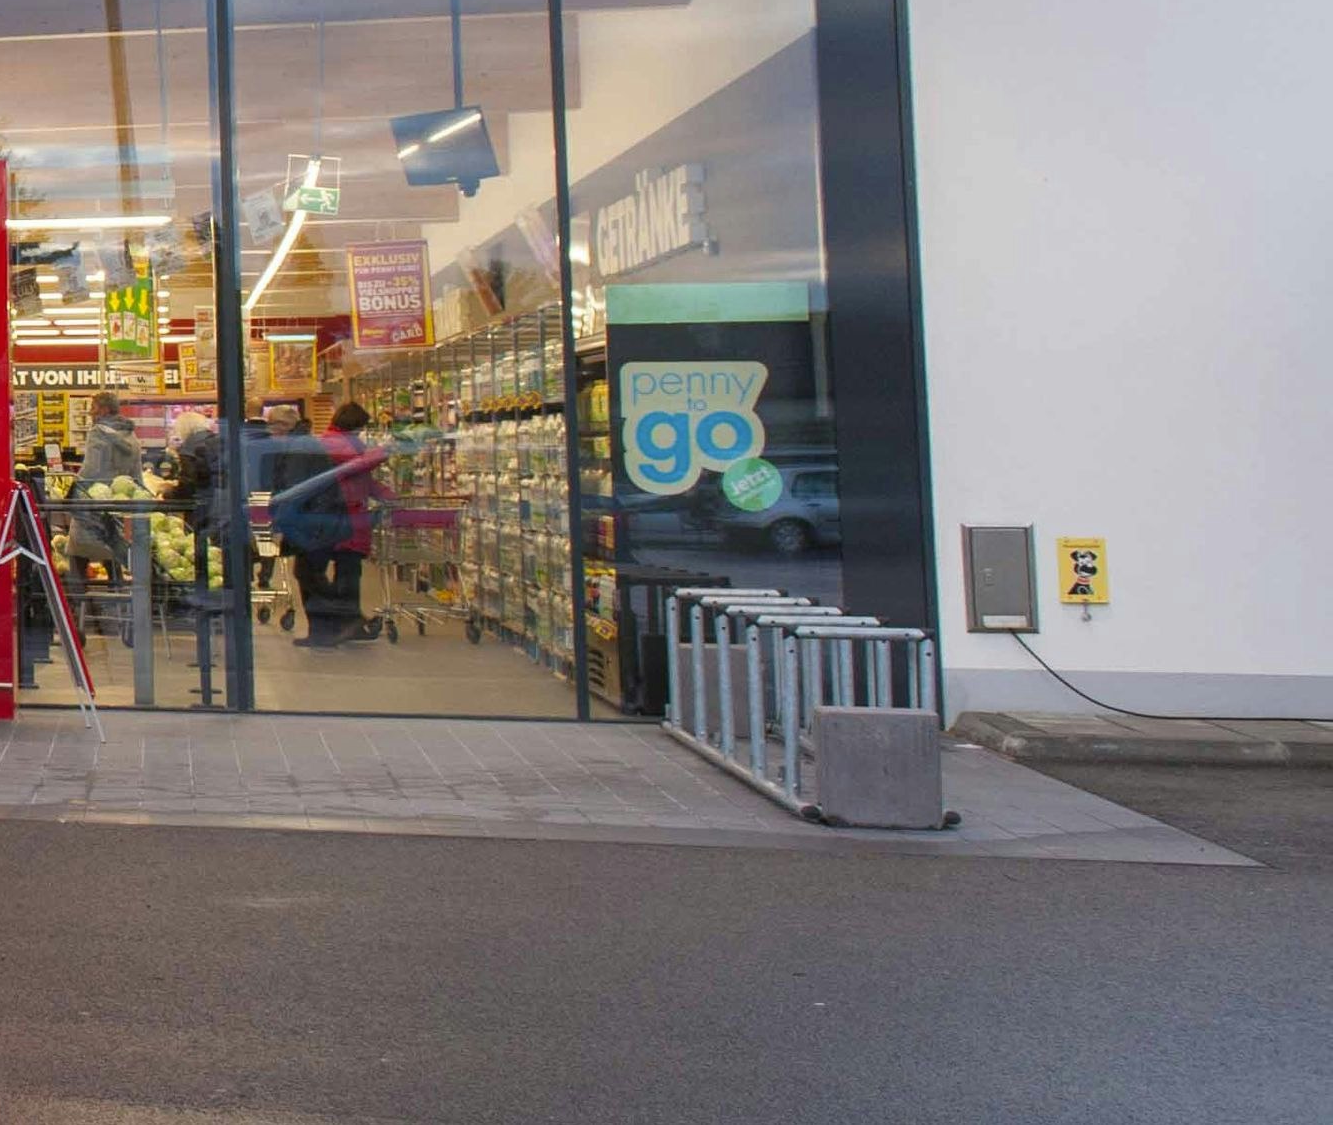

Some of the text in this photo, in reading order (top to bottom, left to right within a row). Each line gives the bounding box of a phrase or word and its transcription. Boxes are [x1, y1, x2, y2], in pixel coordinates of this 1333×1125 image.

[597, 164, 691, 277] GETRÄNKE
[354, 253, 420, 267] EXKLUSIV
[359, 295, 422, 311] BONUS
[31, 370, 74, 385] VON
[631, 372, 758, 406] penny
[687, 398, 707, 411] to
[635, 411, 753, 484] go
